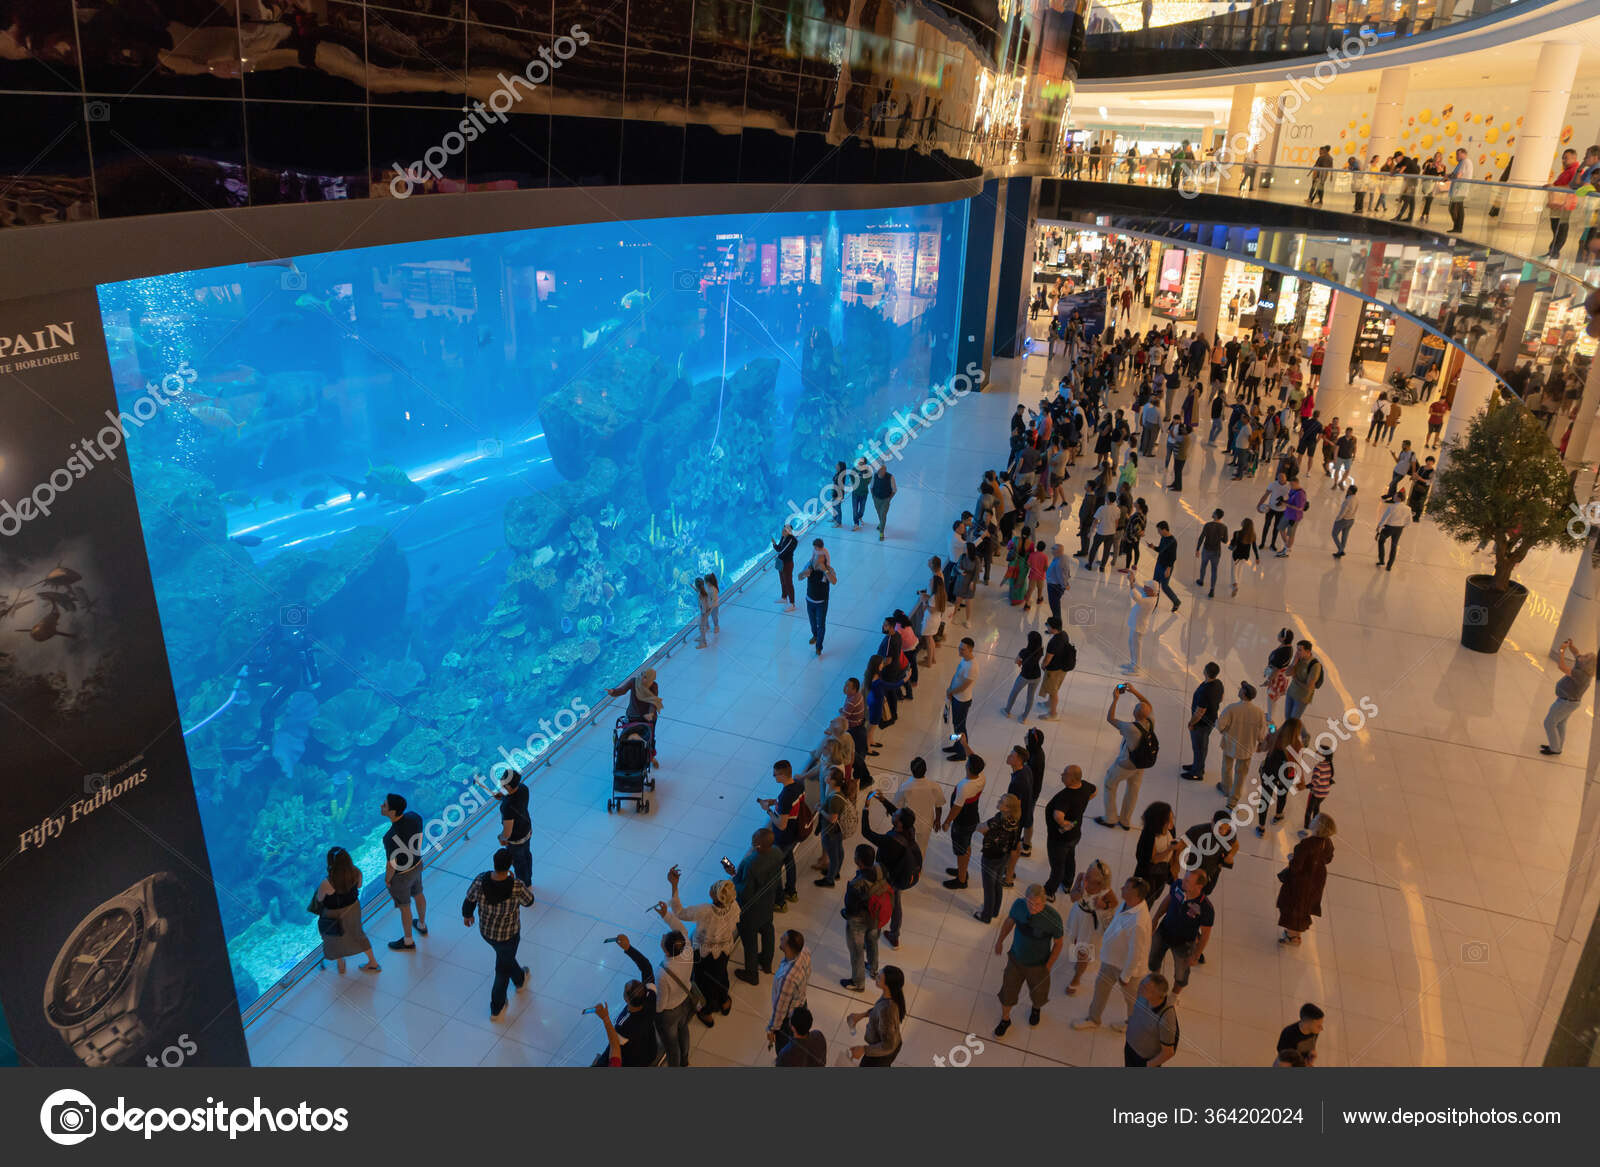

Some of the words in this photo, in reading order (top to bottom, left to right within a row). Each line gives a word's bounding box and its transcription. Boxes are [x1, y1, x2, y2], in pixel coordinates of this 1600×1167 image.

[1290, 124, 1314, 139] am
[1281, 142, 1322, 166] happ
[0, 321, 76, 358] PAIN
[15, 351, 80, 372] HORLOGERIE
[19, 816, 65, 853] Fifty
[69, 768, 148, 823] Fathoms
